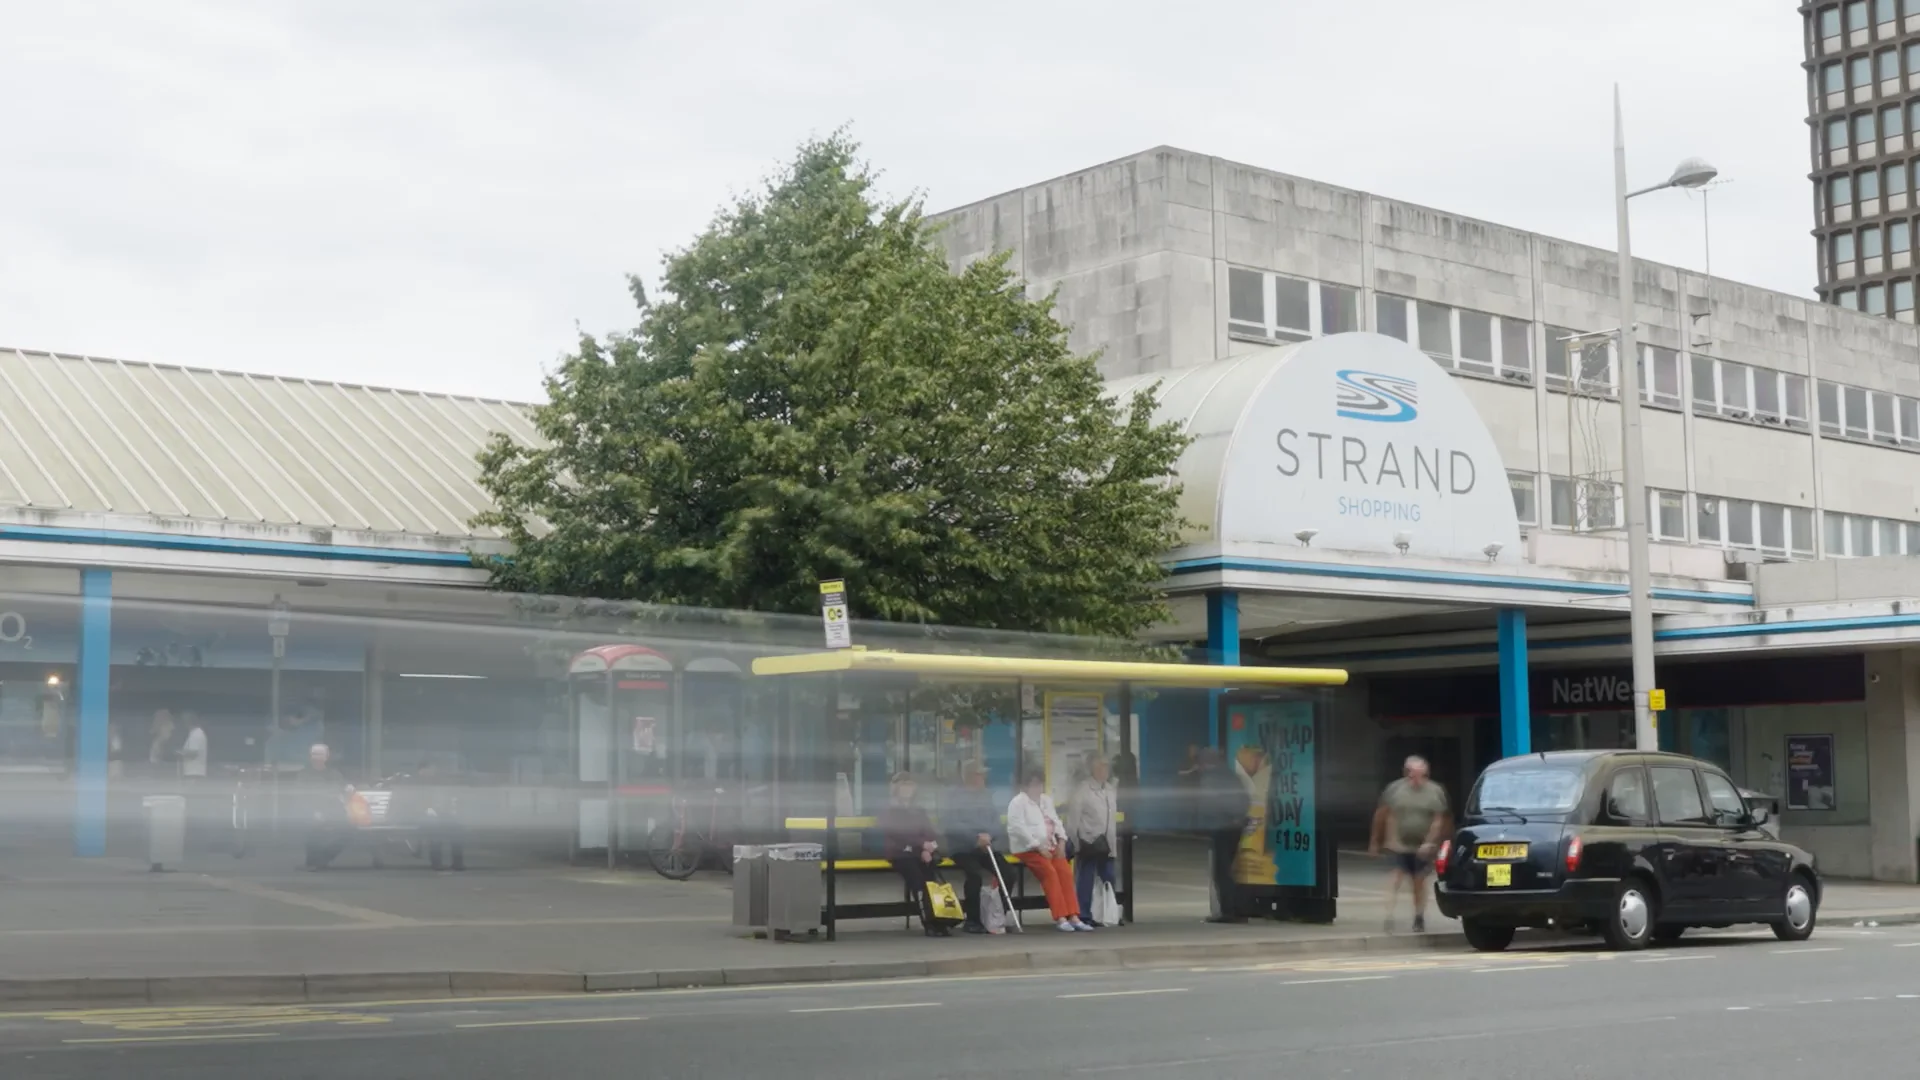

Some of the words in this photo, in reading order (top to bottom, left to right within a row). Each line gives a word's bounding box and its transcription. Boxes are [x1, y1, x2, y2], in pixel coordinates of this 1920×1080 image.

[1276, 428, 1476, 495] STRAND
[1339, 496, 1421, 522] SHOPPING
[1552, 676, 1636, 703] NatWe
[1258, 722, 1312, 753] WRAP
[1278, 751, 1295, 771] OF
[1273, 772, 1300, 796] THE
[1271, 798, 1304, 828] DAY
[1275, 829, 1311, 851] £1.99
